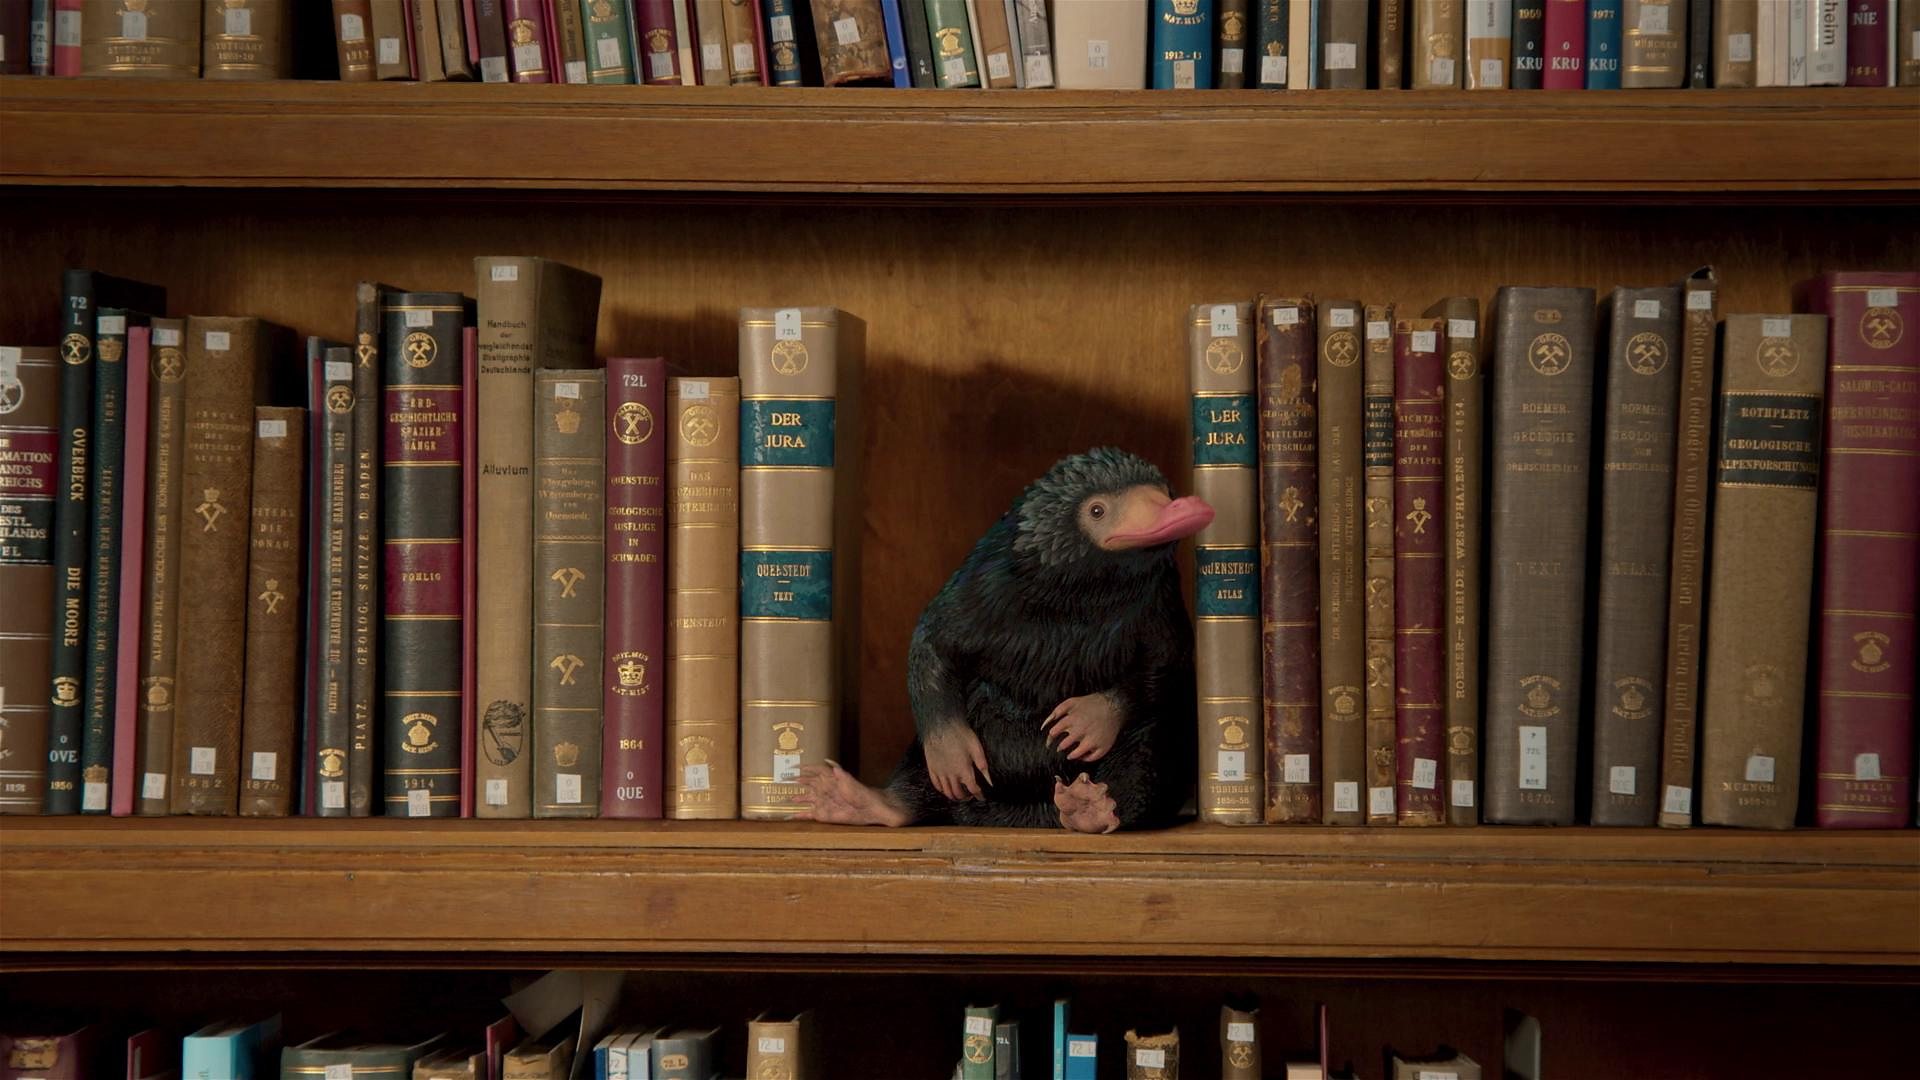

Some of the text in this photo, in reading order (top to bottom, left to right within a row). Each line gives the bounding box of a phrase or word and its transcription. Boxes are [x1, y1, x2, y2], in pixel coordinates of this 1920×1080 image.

[1853, 12, 1877, 25] NIE
[1517, 57, 1543, 70] KRU
[1552, 57, 1580, 70] KRU
[1590, 58, 1617, 71] KRU
[70, 296, 87, 309] 72
[74, 313, 82, 325] L
[487, 320, 527, 329] Handbuch
[623, 374, 647, 388] 72L
[771, 413, 802, 426] DER
[765, 435, 805, 448] JURA
[1206, 432, 1245, 446] JURA
[1728, 438, 1811, 453] GEOLOGISCHE
[70, 428, 86, 501] OVERBECK
[483, 464, 529, 475] Alluvium
[333, 463, 345, 523] BRANDENBURG
[628, 538, 639, 547] IN
[155, 535, 167, 584] GEOLOGIE
[402, 573, 441, 582] POHLIG
[1216, 589, 1243, 599] ATLAS
[64, 567, 80, 647] DIE MOORE
[151, 620, 163, 661] ALFRED
[619, 740, 643, 750] 1864
[50, 750, 77, 762] OVE
[404, 779, 435, 788] 1914
[616, 787, 644, 799] QUE
